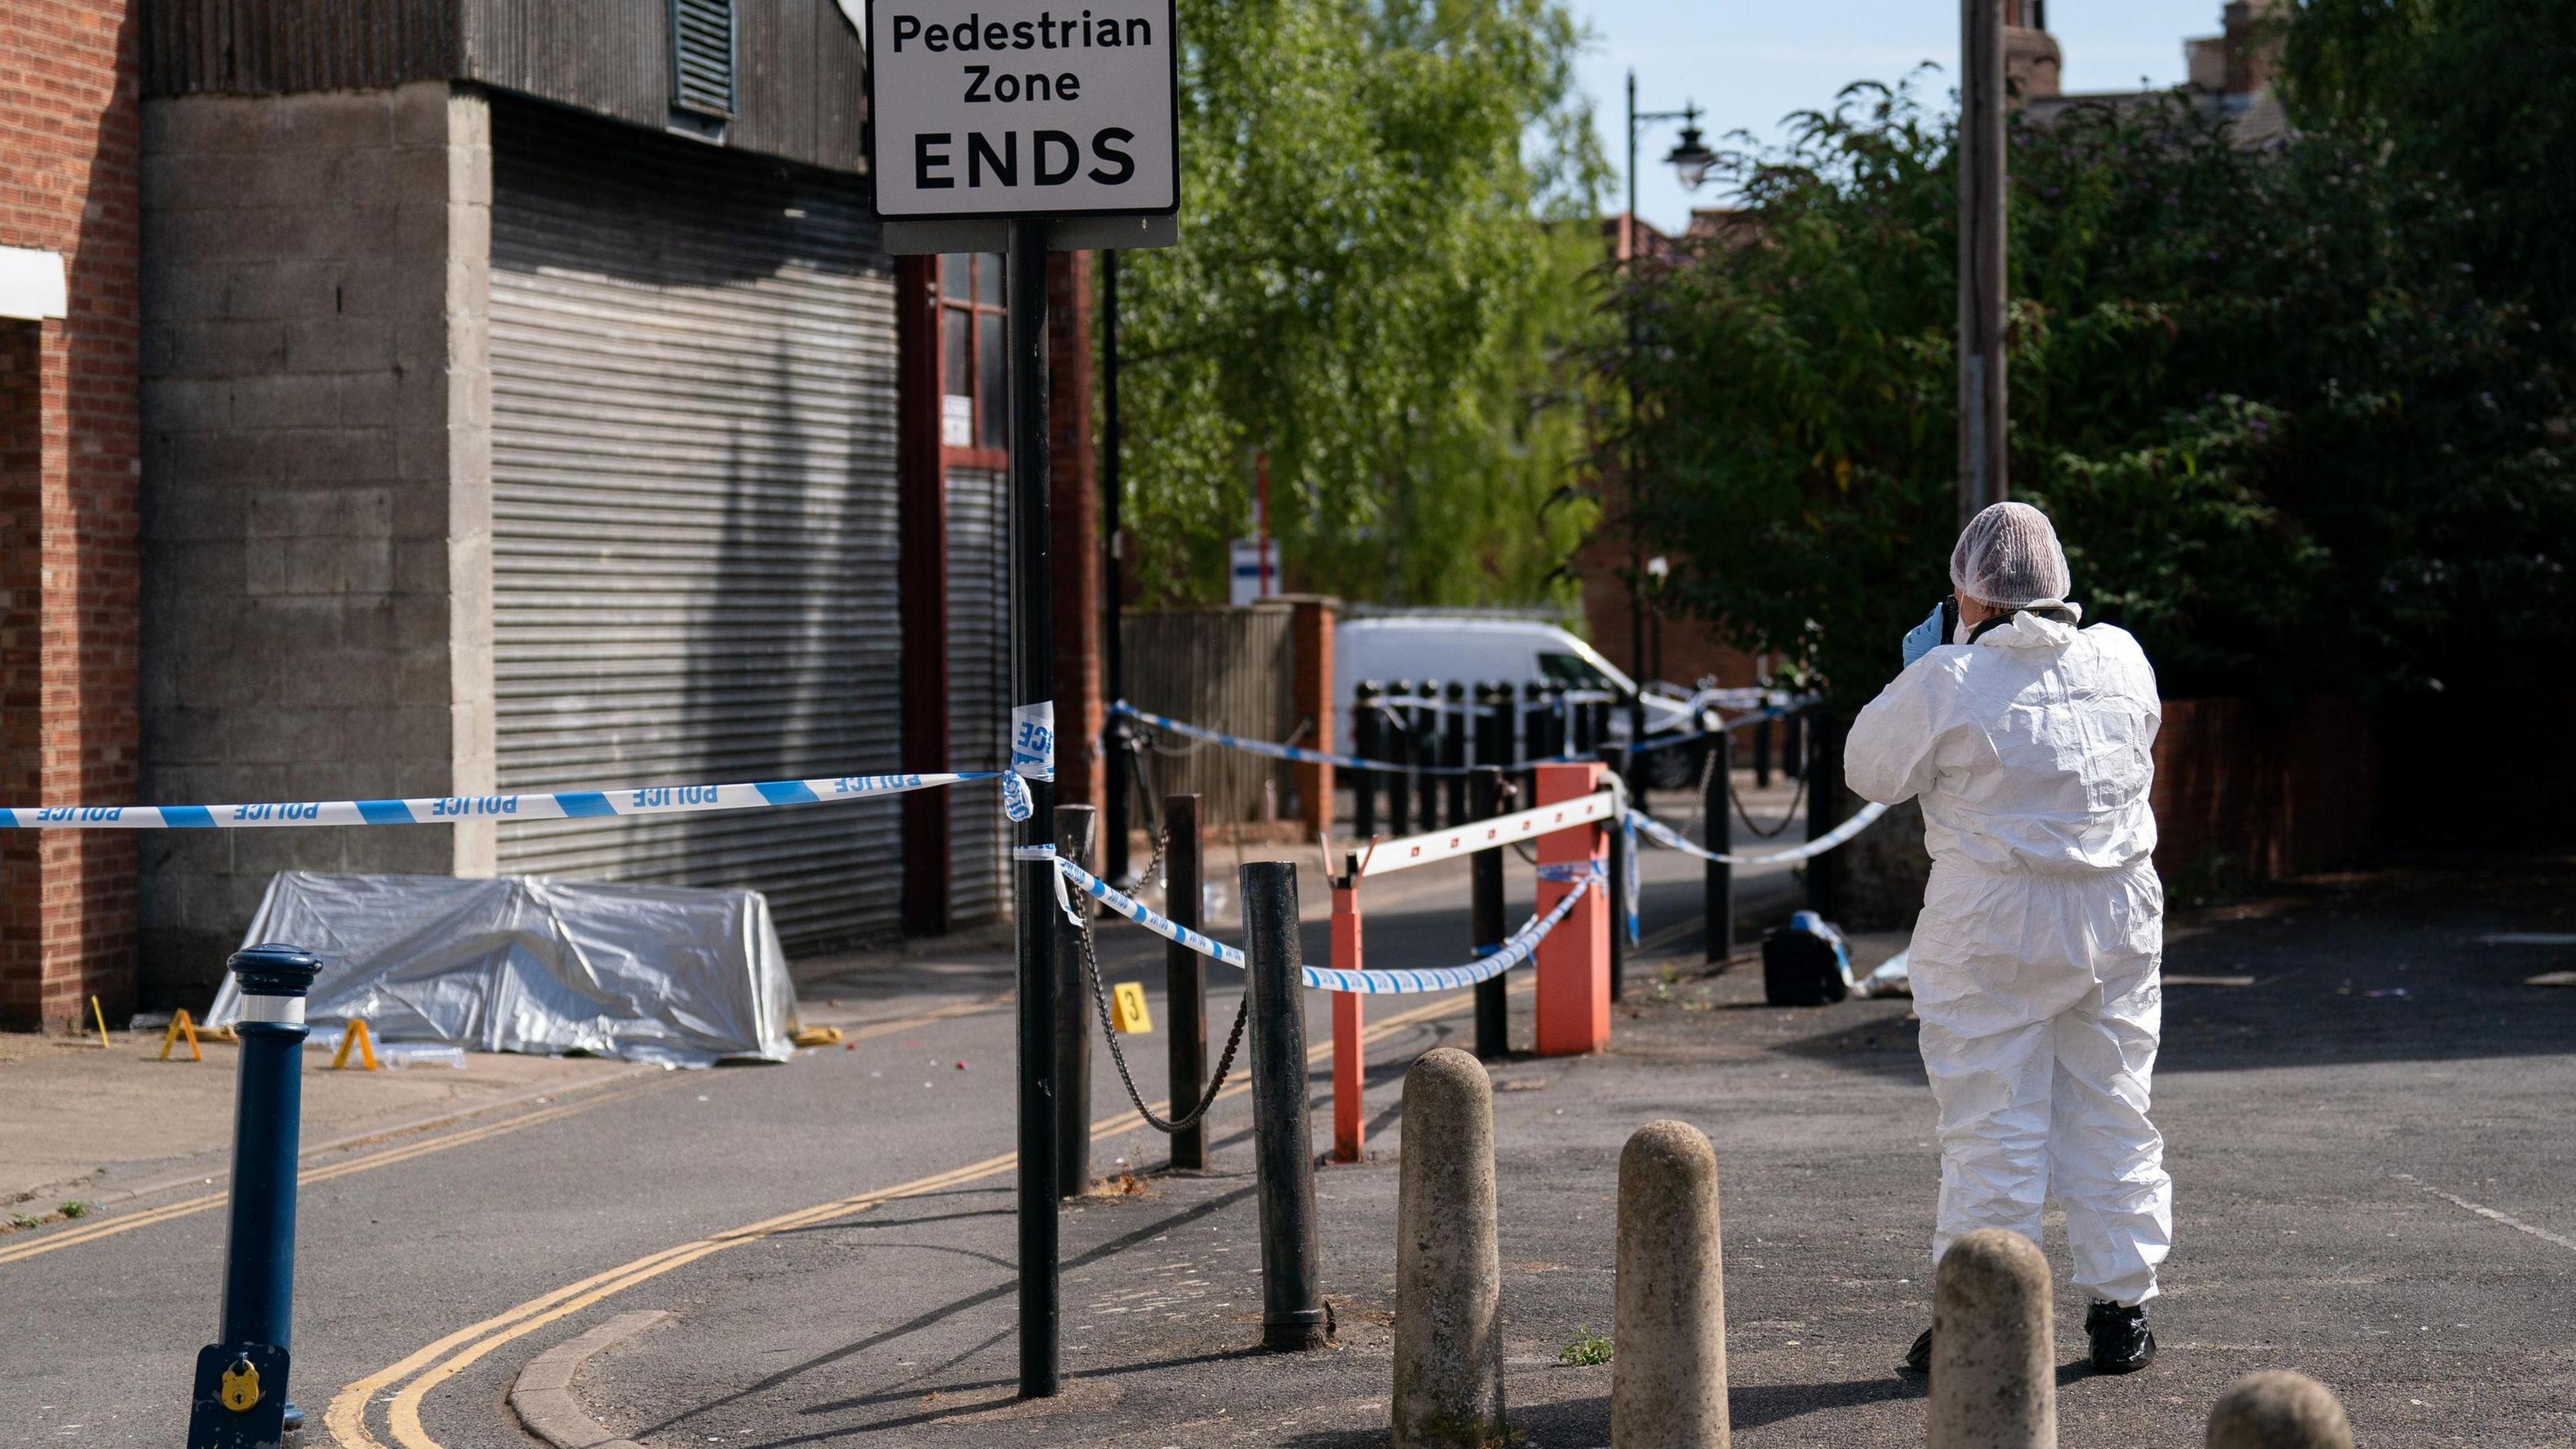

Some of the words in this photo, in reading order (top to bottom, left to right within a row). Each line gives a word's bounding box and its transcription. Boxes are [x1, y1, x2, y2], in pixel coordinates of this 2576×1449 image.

[894, 10, 1151, 52] Pedestrian
[964, 65, 1081, 103] Zone
[915, 127, 1135, 189] ENDS
[233, 802, 321, 820] POLICE
[432, 795, 518, 816] POLICE
[633, 785, 718, 808] POLICE
[1124, 991, 1139, 1022] 3
